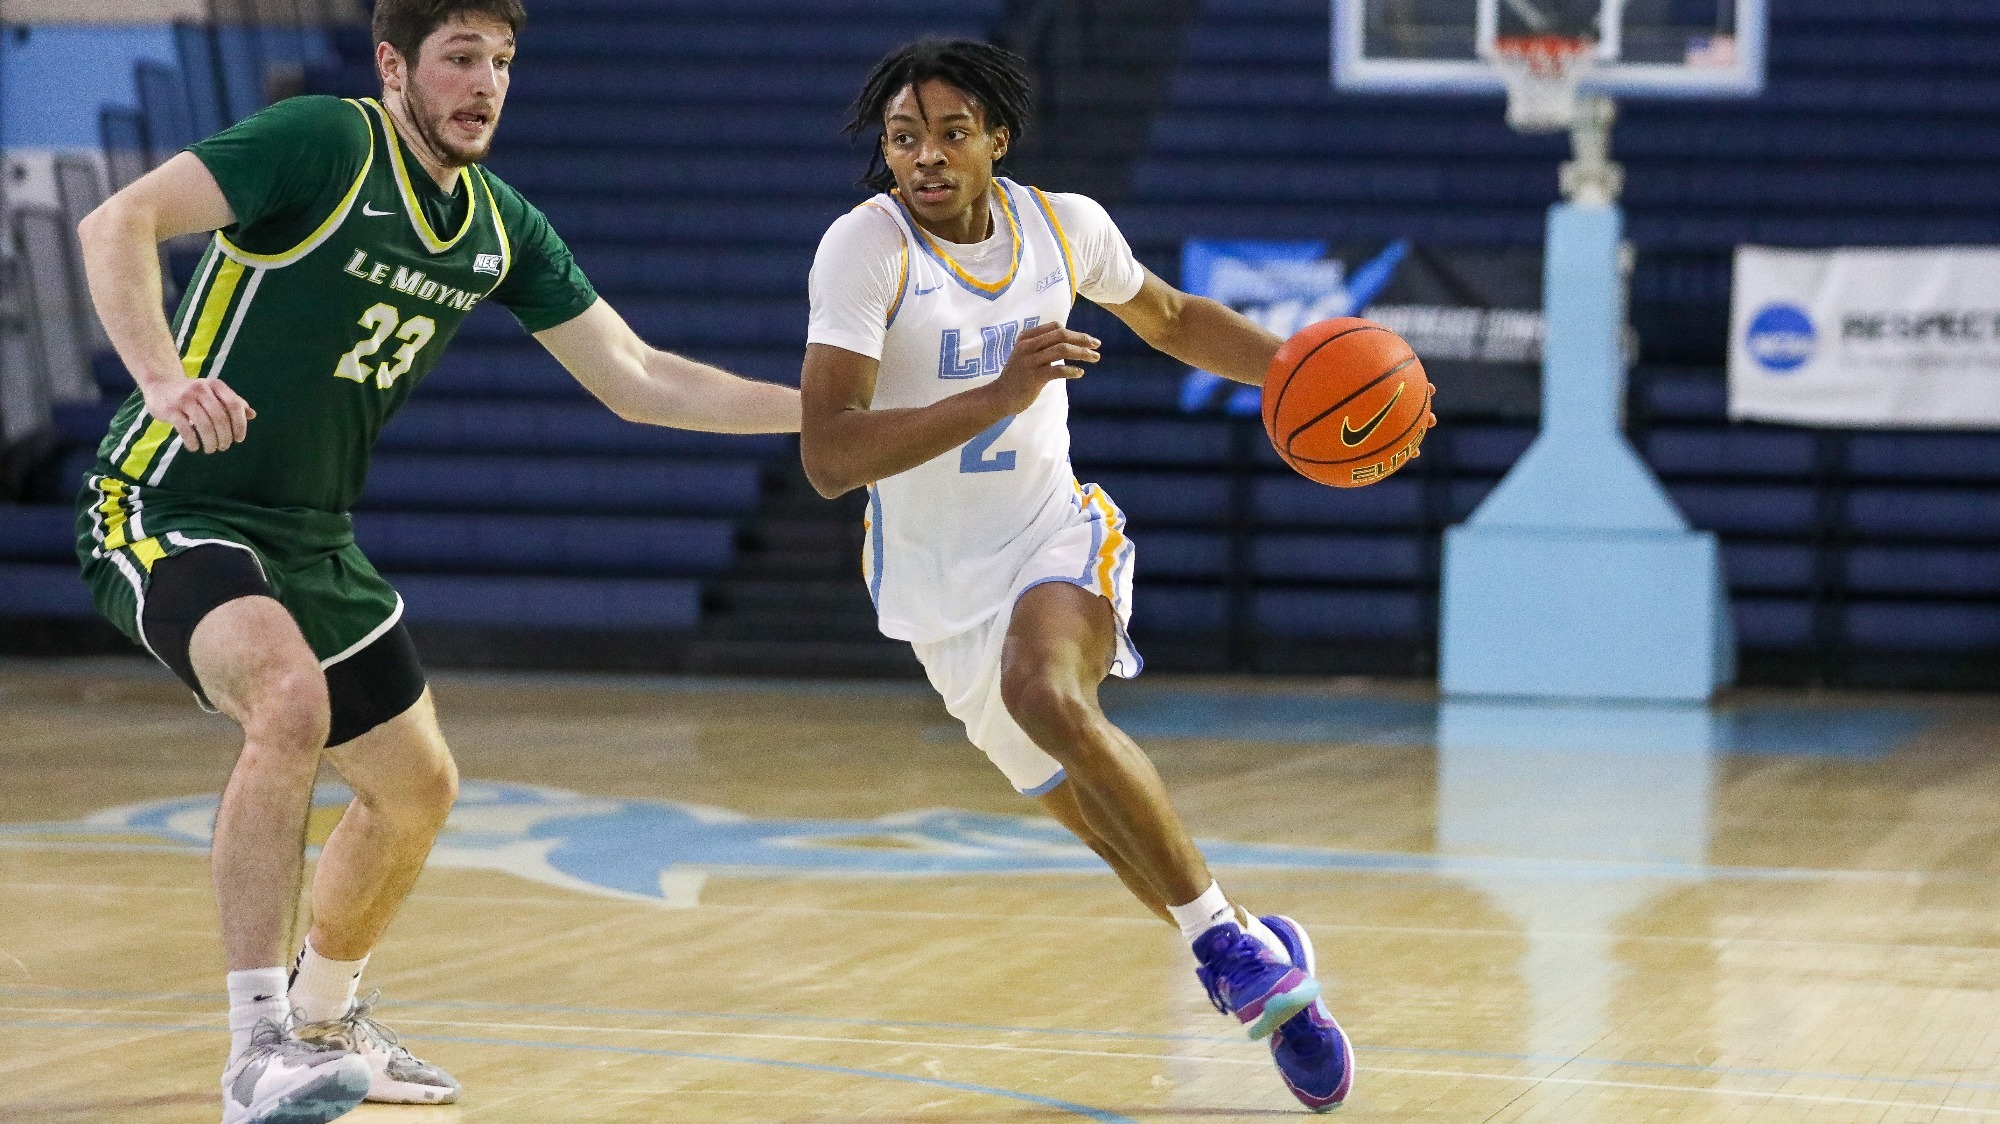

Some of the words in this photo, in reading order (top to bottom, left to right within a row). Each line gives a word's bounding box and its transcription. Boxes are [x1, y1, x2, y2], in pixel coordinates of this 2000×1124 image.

[390, 265, 482, 311] MOYNE
[474, 254, 502, 272] NEC
[334, 302, 436, 389] 23
[960, 414, 1017, 473] 2
[1351, 428, 1425, 480] ELITE
